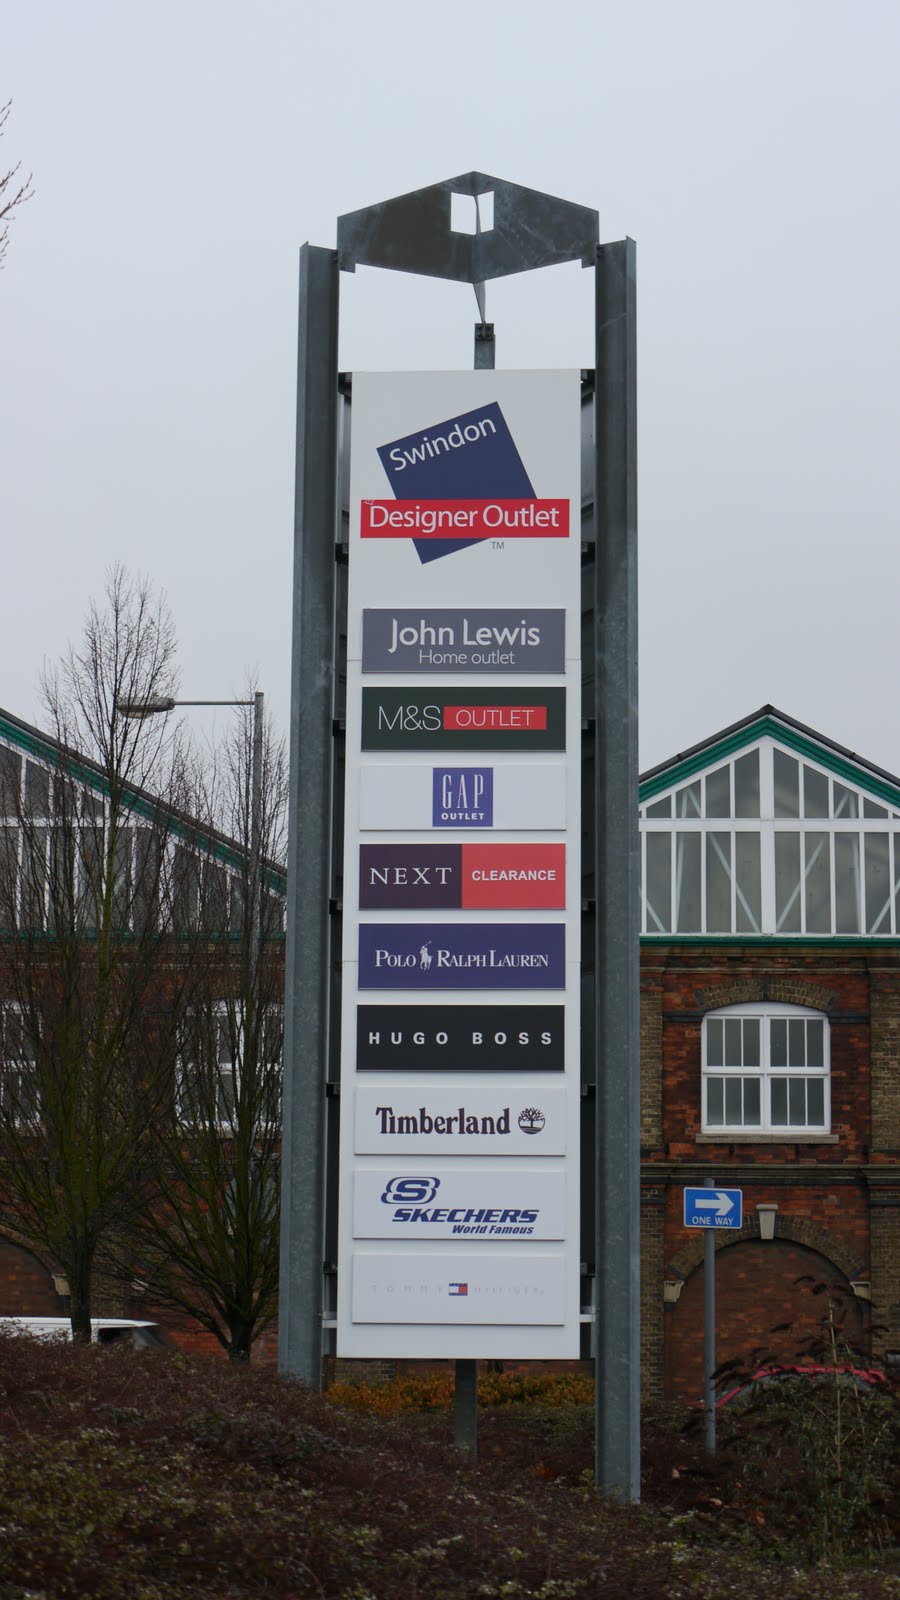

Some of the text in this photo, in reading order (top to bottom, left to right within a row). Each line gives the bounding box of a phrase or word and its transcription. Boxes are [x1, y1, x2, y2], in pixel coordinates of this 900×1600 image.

[389, 418, 497, 471] Swindon
[369, 503, 560, 534] Designer Outlet
[387, 618, 541, 653] John Lewis
[419, 650, 515, 664] Home outlet
[378, 705, 534, 731] M&S OUTLET
[441, 774, 484, 809] GAP
[441, 812, 485, 820] OUTLET
[369, 867, 556, 885] NEXT CLEARANCE
[369, 1032, 552, 1045] HUGO BOSS
[375, 1107, 511, 1135] Timberland
[392, 1208, 539, 1223] SKECHERS
[692, 1216, 734, 1226] ONE WAY
[452, 1224, 534, 1235] World Famous
